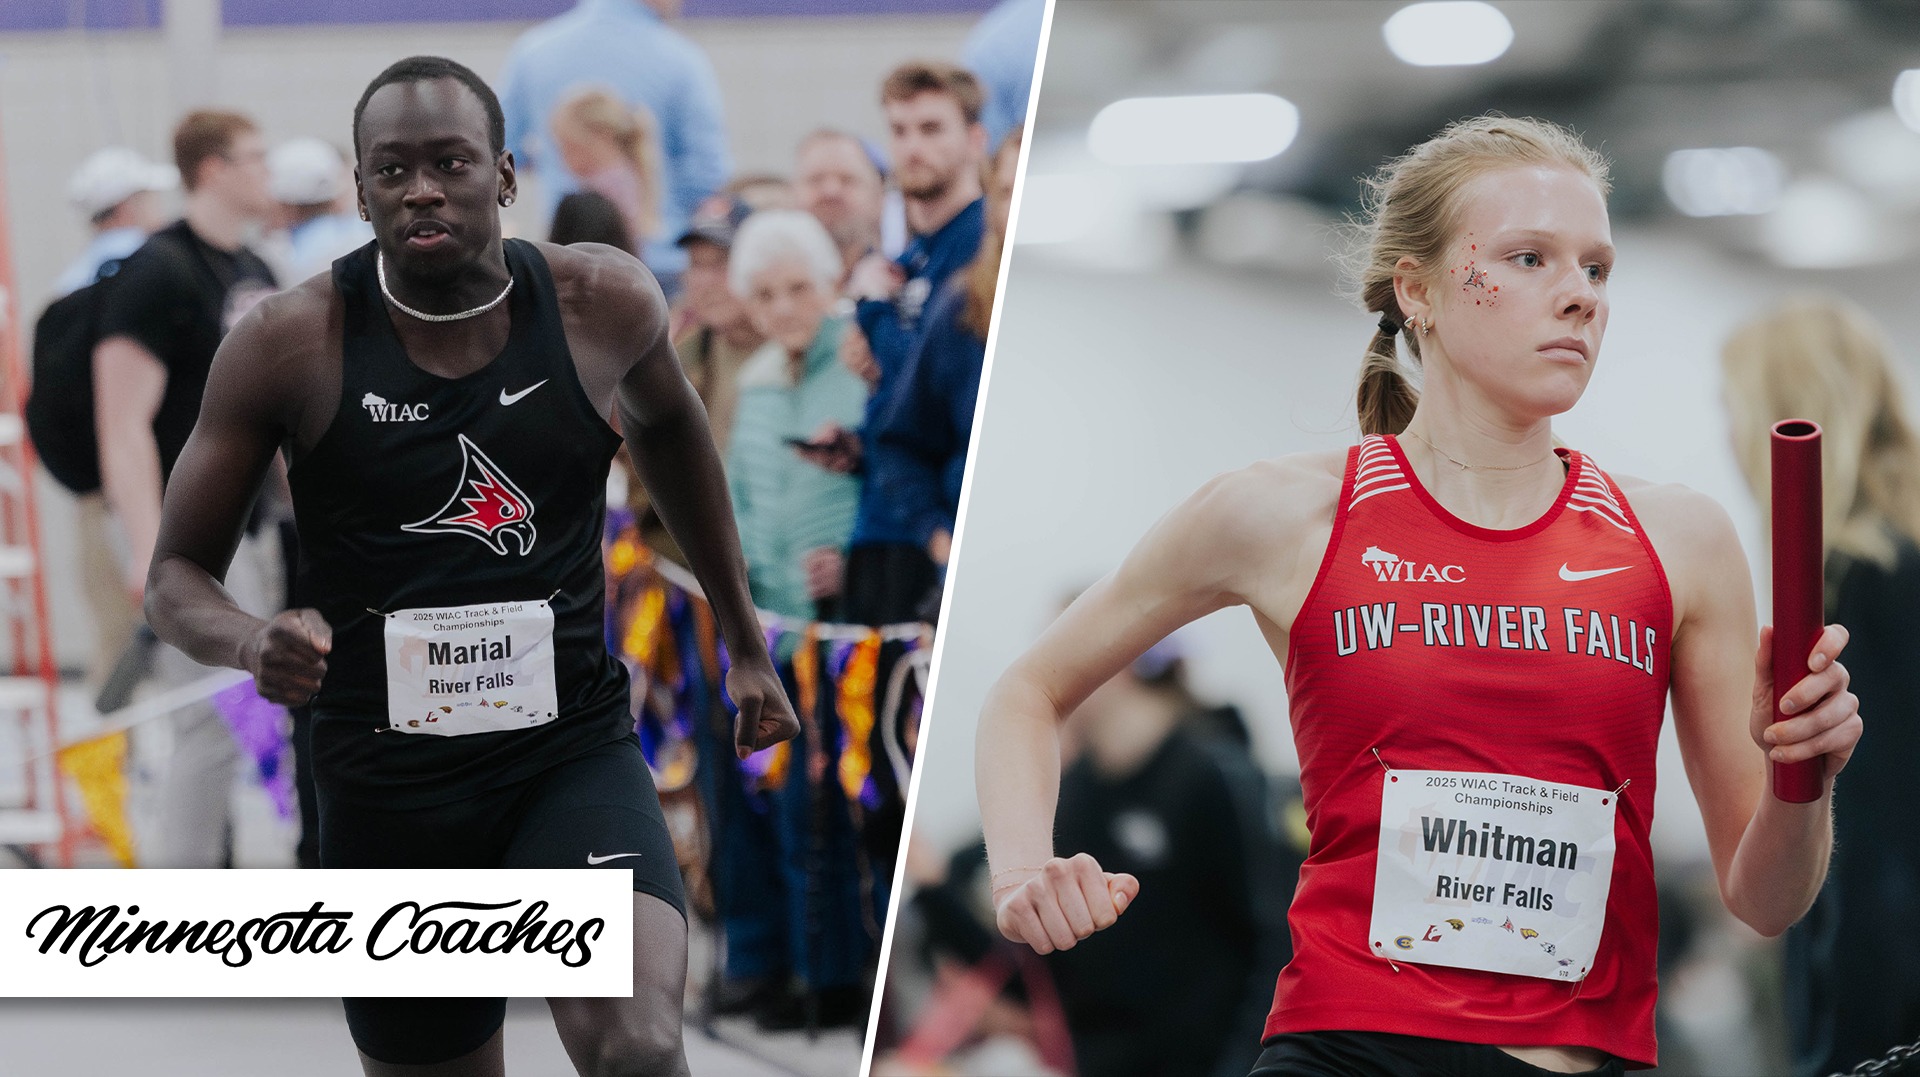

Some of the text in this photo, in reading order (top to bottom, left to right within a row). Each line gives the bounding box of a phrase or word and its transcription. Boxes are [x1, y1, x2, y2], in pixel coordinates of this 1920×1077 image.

[364, 397, 430, 422] WIAC
[1364, 551, 1466, 583] WIAC
[413, 604, 523, 621] 2025 WIAC Track & Field
[433, 617, 505, 632] Championships
[428, 635, 512, 666] Marial
[1333, 602, 1657, 676] UW-RIVER FALLS
[429, 672, 514, 694] River Falls
[1425, 776, 1580, 803] 2025 WIAC Track & Field
[1454, 793, 1553, 815] Championships
[1420, 816, 1579, 871] Whitman
[1436, 875, 1554, 912] River Falls
